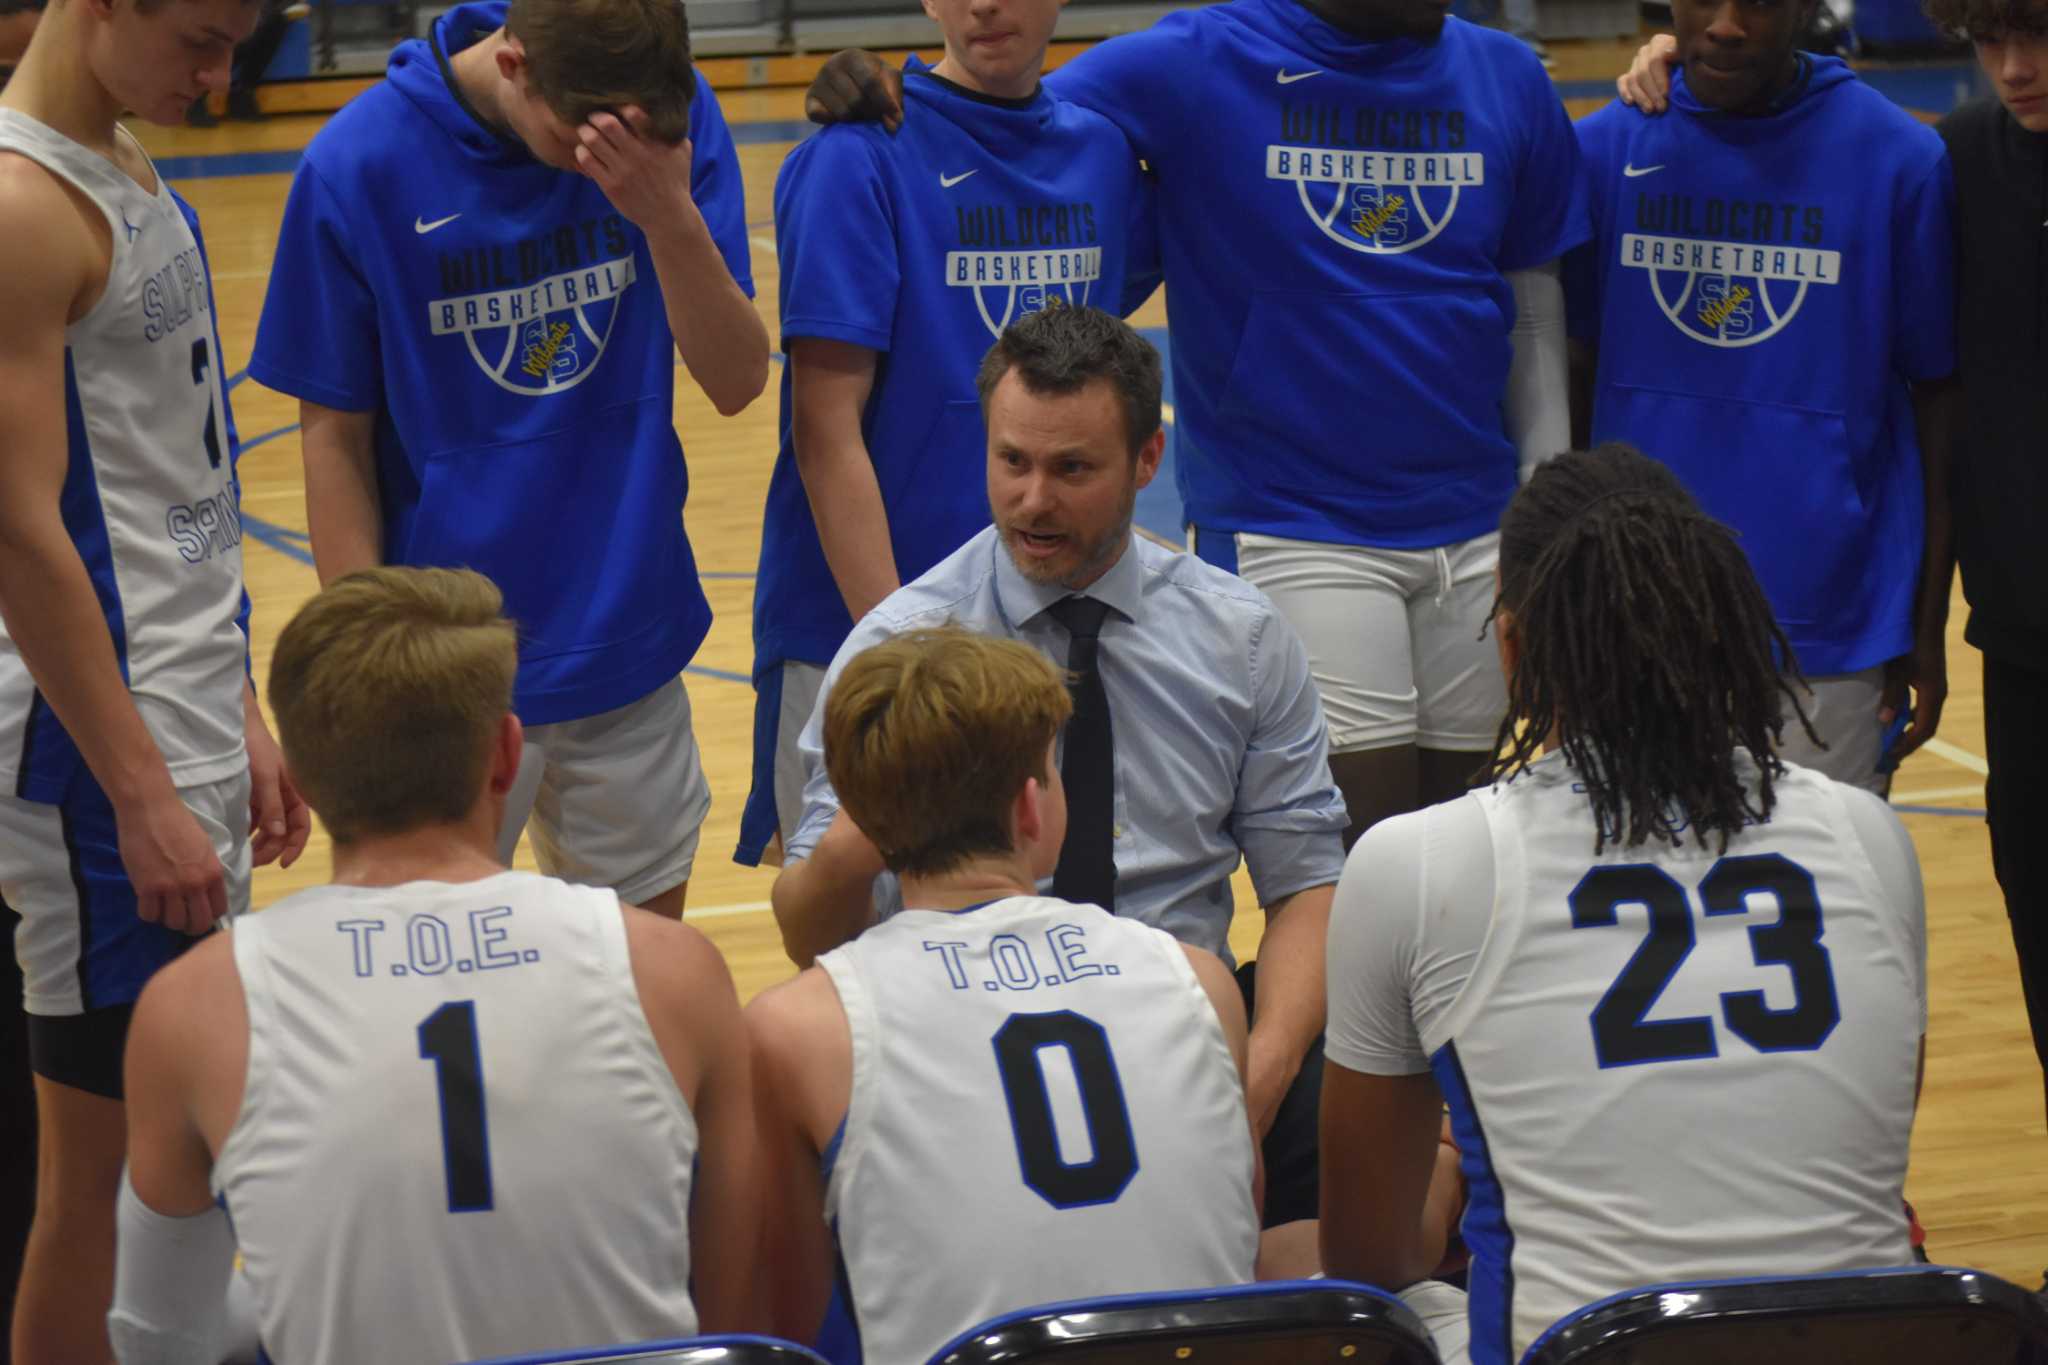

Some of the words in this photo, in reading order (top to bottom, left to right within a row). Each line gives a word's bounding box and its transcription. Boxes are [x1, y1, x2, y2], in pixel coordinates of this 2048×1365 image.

[1279, 102, 1466, 149] WILDCATS
[1278, 151, 1475, 182] BASKETBALL
[956, 203, 1098, 247] WILDCATS
[1635, 192, 1825, 244] WILDCATS
[438, 213, 627, 293] WILDCATS
[957, 253, 1097, 282] BASKETBALL
[1632, 239, 1827, 279] BASKETBALL
[441, 261, 630, 330] BASKETBALL
[338, 906, 540, 977] T.O.E.
[924, 923, 1121, 992] T.O.E.
[1567, 852, 1842, 1070] 23
[416, 999, 495, 1213] 1
[991, 1008, 1140, 1211] 0
